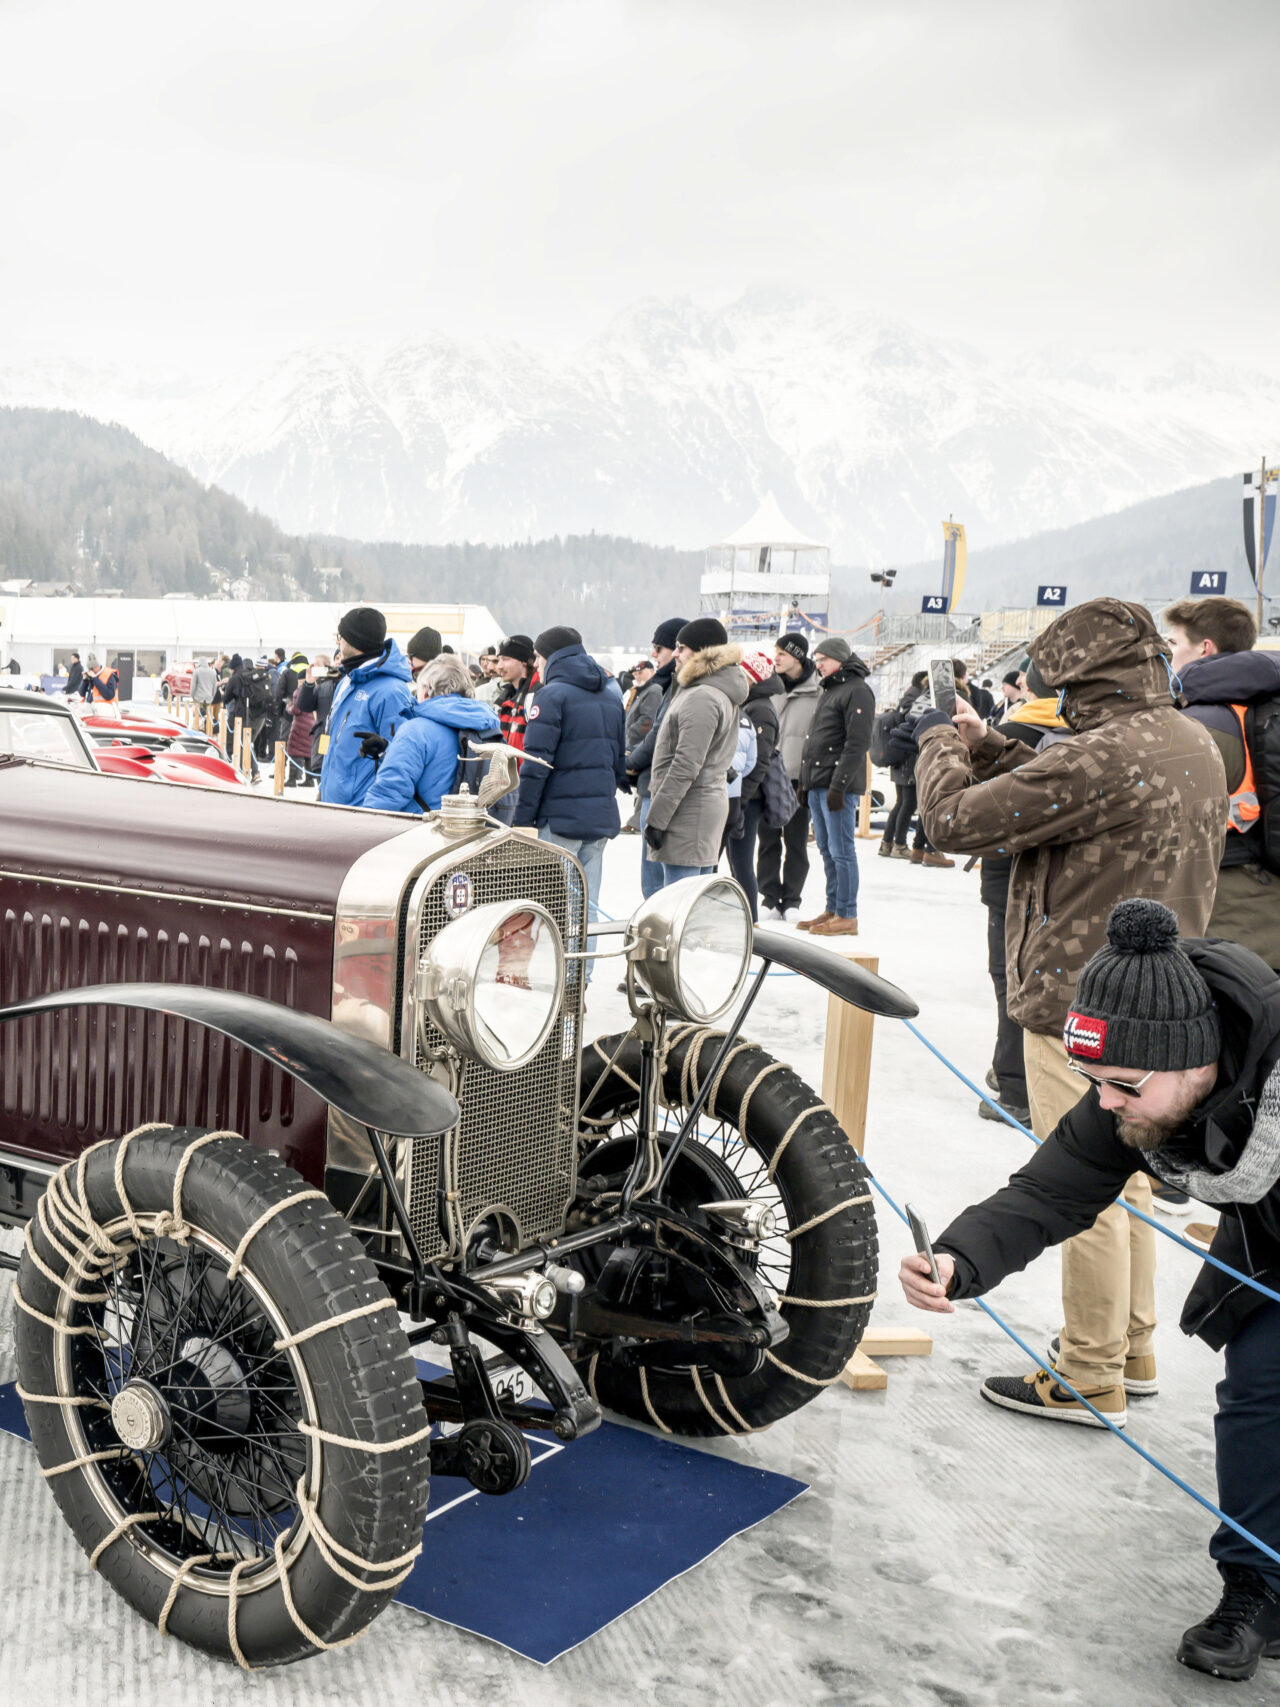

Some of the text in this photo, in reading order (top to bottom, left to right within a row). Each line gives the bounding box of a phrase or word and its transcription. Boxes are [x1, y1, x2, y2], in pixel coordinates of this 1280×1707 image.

[1199, 573, 1219, 588] A1
[1043, 587, 1061, 600] A2
[927, 597, 943, 609] A3
